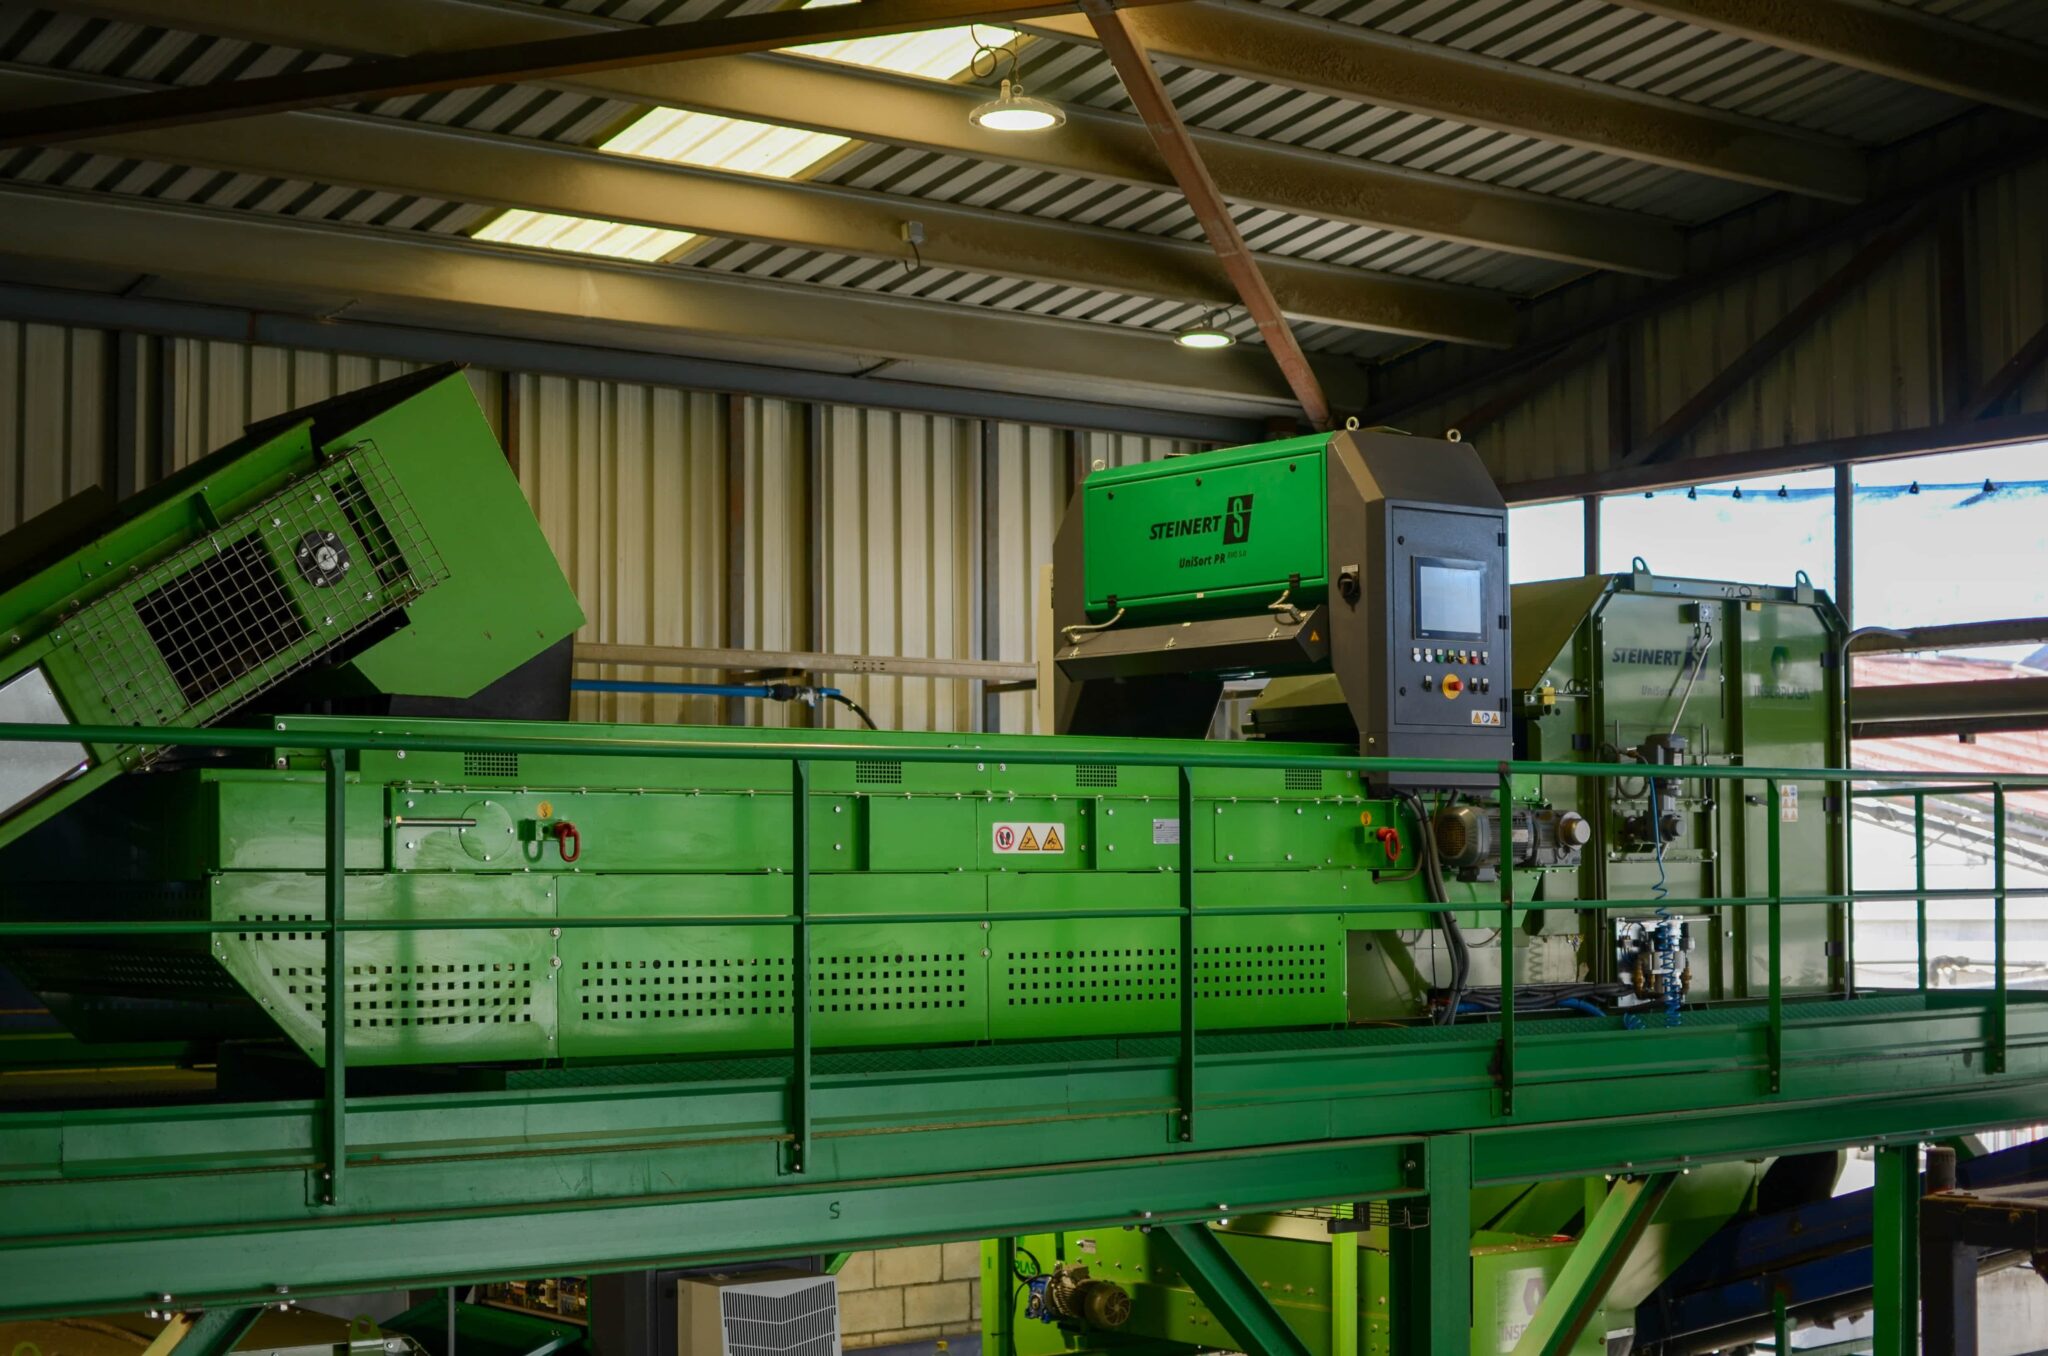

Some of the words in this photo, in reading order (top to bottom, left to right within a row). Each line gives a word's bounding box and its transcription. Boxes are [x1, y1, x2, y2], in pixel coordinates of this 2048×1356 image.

[1149, 515, 1222, 540] STEINERT
[1179, 555, 1212, 569] UniSort
[1214, 552, 1226, 565] PR
[1612, 647, 1682, 666] STEINERT
[829, 1201, 840, 1220] S
